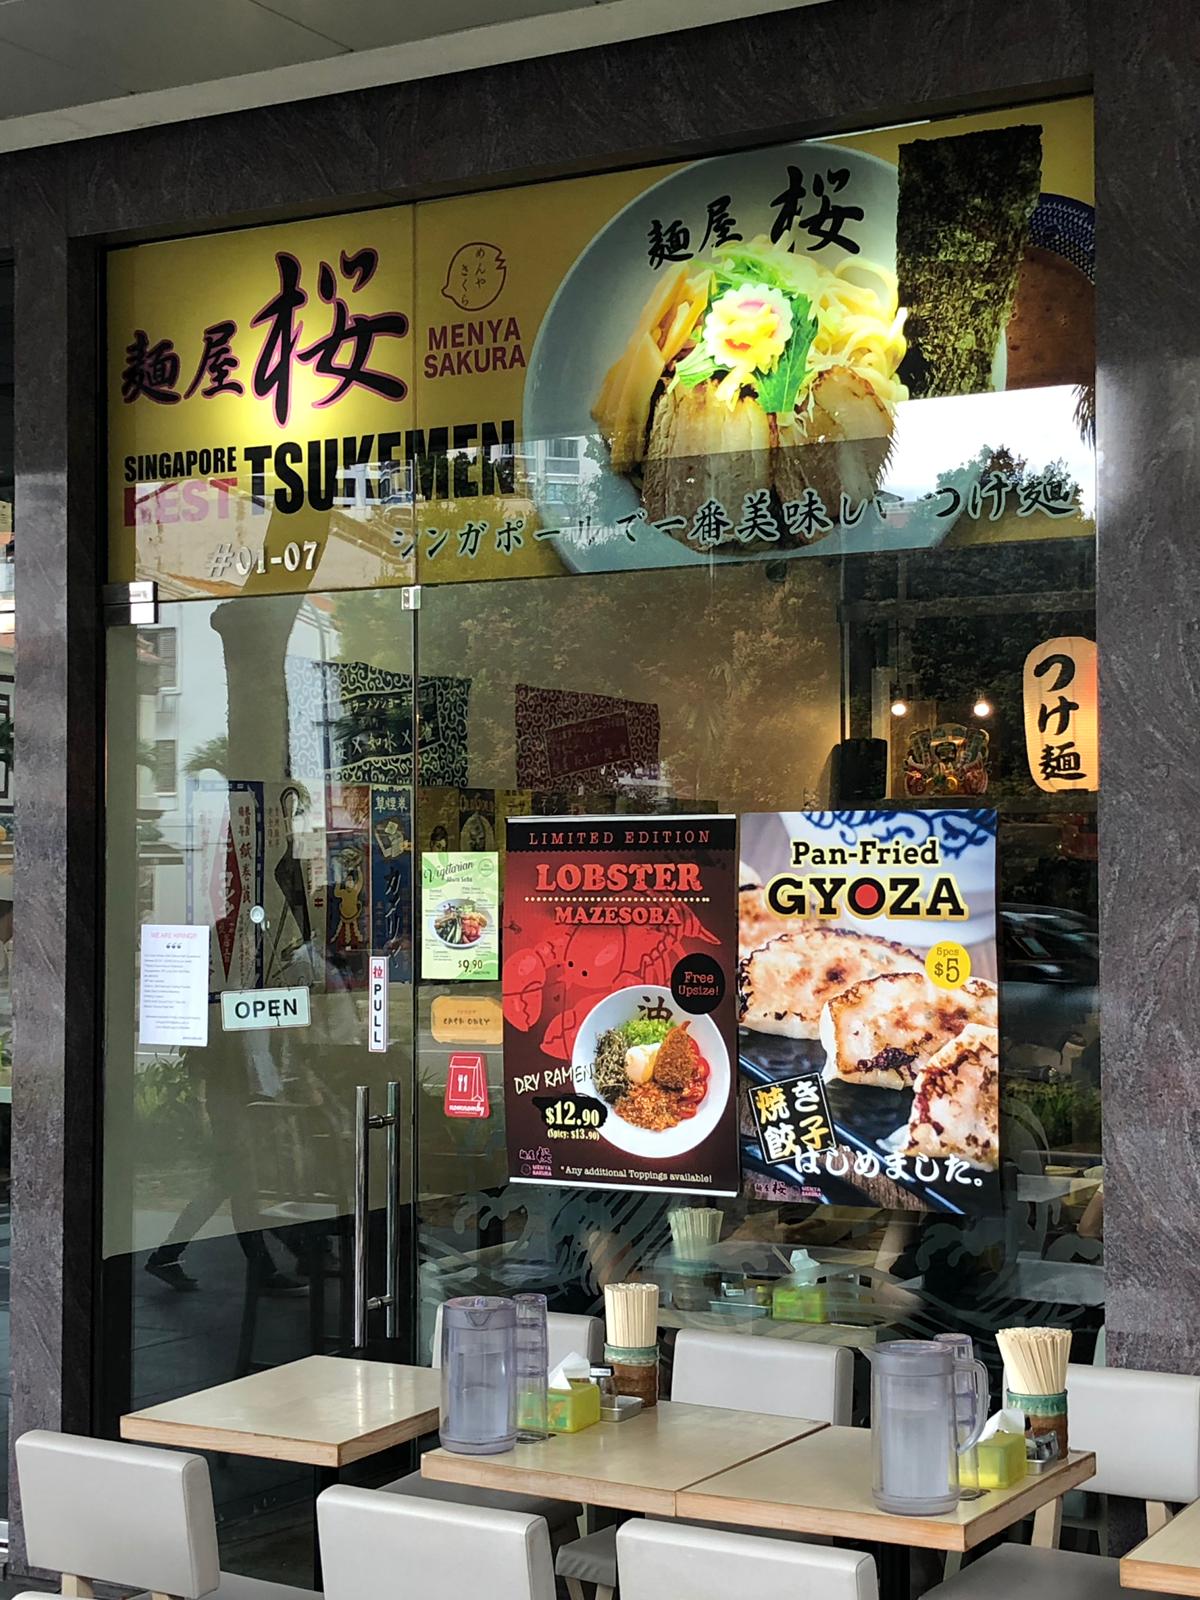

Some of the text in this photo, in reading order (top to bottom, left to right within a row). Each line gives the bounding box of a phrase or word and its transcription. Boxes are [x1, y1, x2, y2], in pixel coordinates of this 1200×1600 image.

[429, 317, 521, 350] MENYA
[424, 345, 526, 378] SAKURA
[124, 420, 515, 514] SINGAPORE TSUKEMEN
[124, 478, 238, 526] BEST
[206, 541, 318, 577] #01-07
[1033, 654, 1087, 781] つけ麺
[529, 830, 710, 845] LIMITED EDITION
[792, 840, 939, 865] Pan-Fried
[535, 863, 703, 892] LOBSTER
[768, 877, 965, 916] GYOZA
[554, 907, 682, 925] MAZESOBA
[458, 959, 483, 973] $9.90
[936, 948, 959, 957] 5pcs
[684, 971, 714, 983] Free
[934, 958, 960, 983] $5
[678, 985, 719, 998] Upsize!
[235, 998, 298, 1020] OPEN
[373, 984, 382, 1043] PULL
[514, 1064, 594, 1095] DRY RAMEN
[545, 1100, 600, 1127] $12.90
[584, 1167, 627, 1178] additional
[628, 1169, 668, 1182] Toppings
[669, 1173, 713, 1184] available!
[794, 1145, 984, 1188] はじめました。
